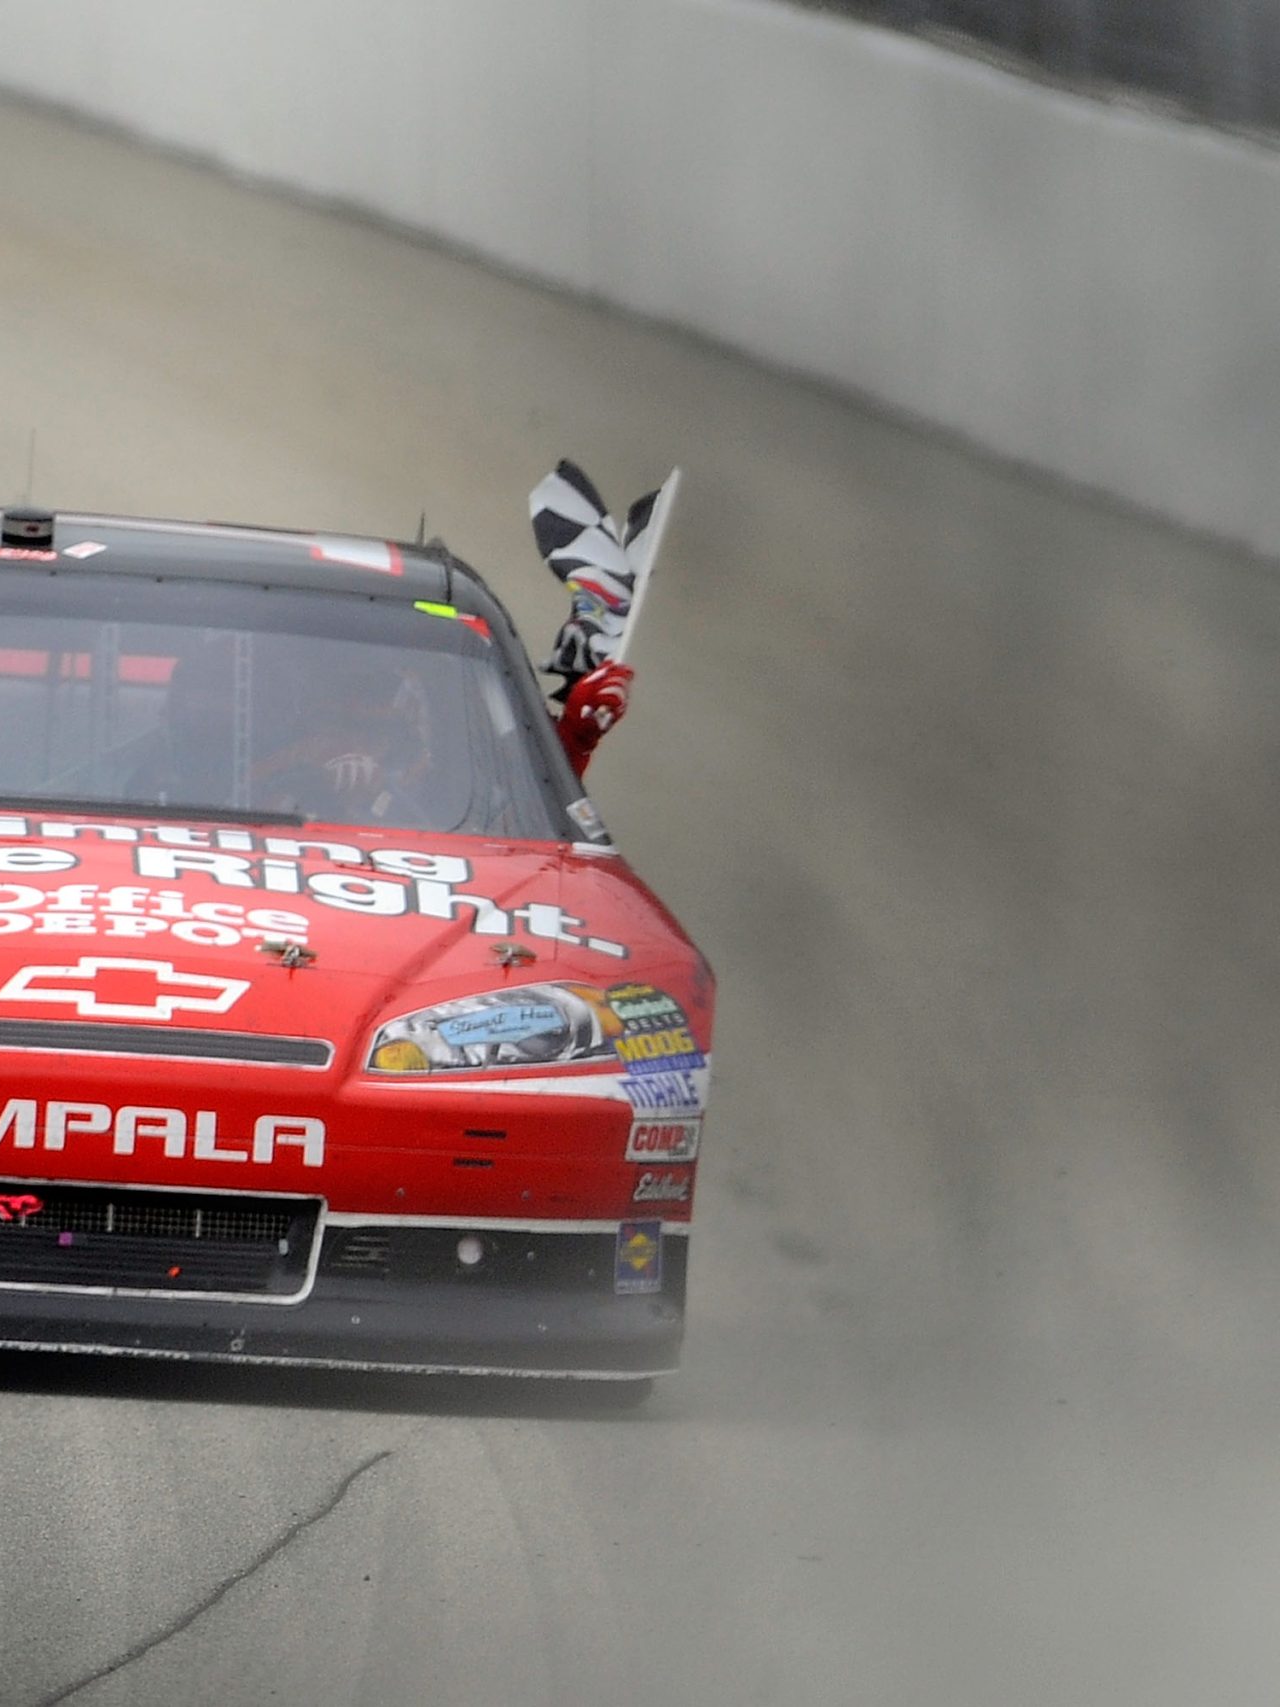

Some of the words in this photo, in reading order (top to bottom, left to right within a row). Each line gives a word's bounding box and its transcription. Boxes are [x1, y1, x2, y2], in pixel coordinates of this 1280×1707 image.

[133, 845, 629, 959] Right.
[627, 1012, 685, 1031] BELTS
[615, 1027, 696, 1063] MOOG
[618, 1069, 699, 1109] MAHLE
[634, 1124, 685, 1152] COMP
